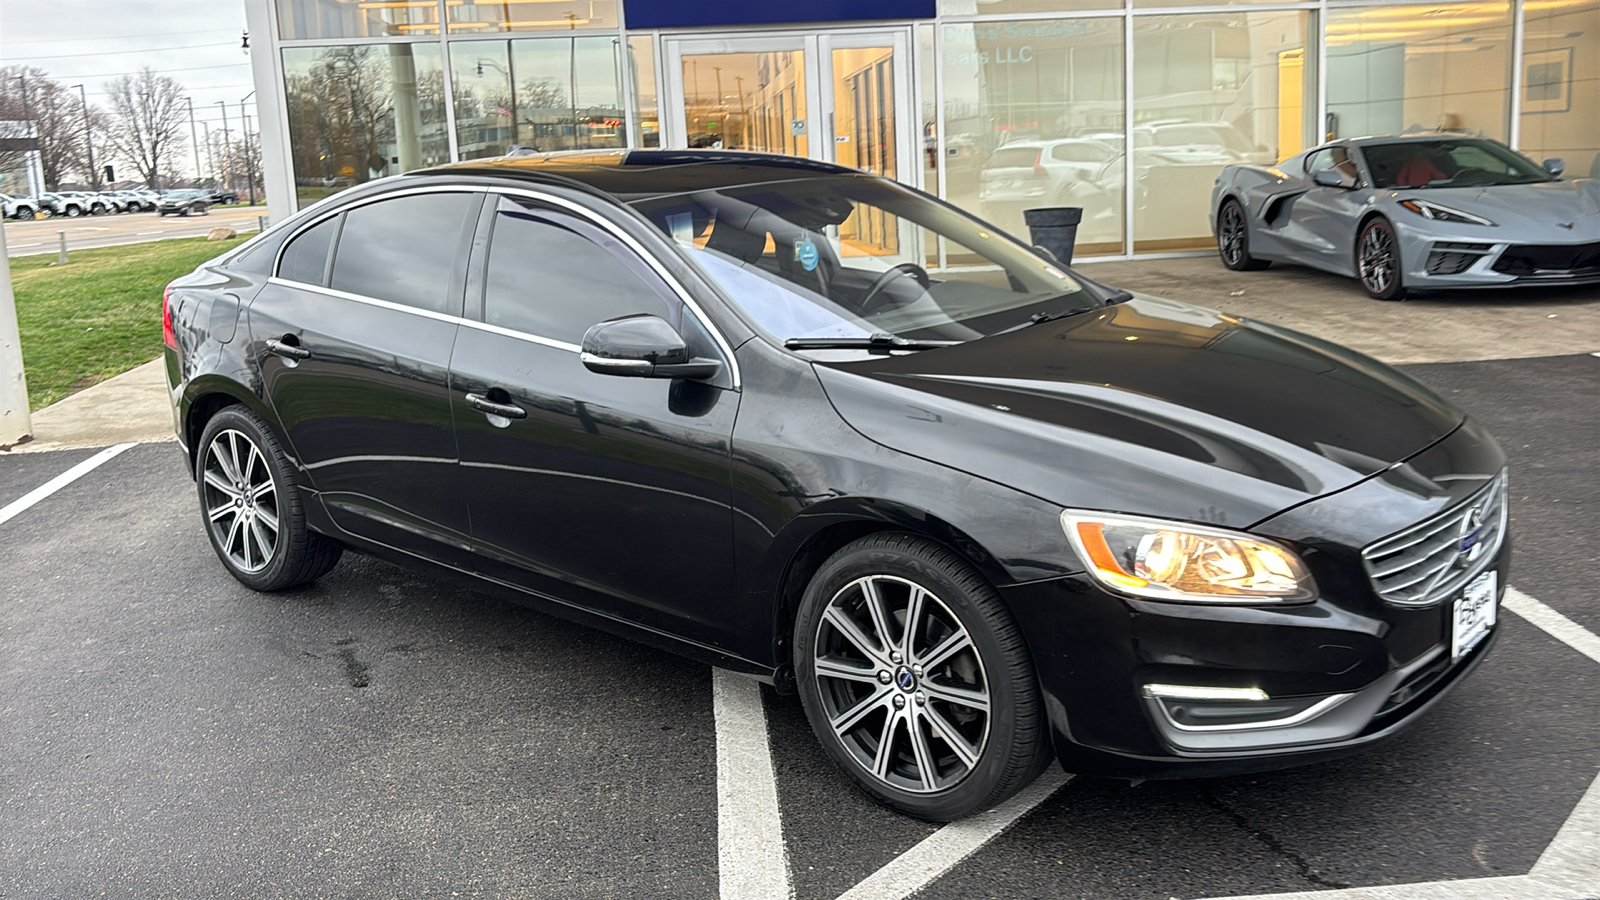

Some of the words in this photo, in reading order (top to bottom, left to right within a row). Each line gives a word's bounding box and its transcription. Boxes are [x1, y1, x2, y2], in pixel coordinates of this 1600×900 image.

[1004, 20, 1087, 39] Swedish
[943, 48, 989, 66] Cars
[995, 45, 1033, 64] LLC
